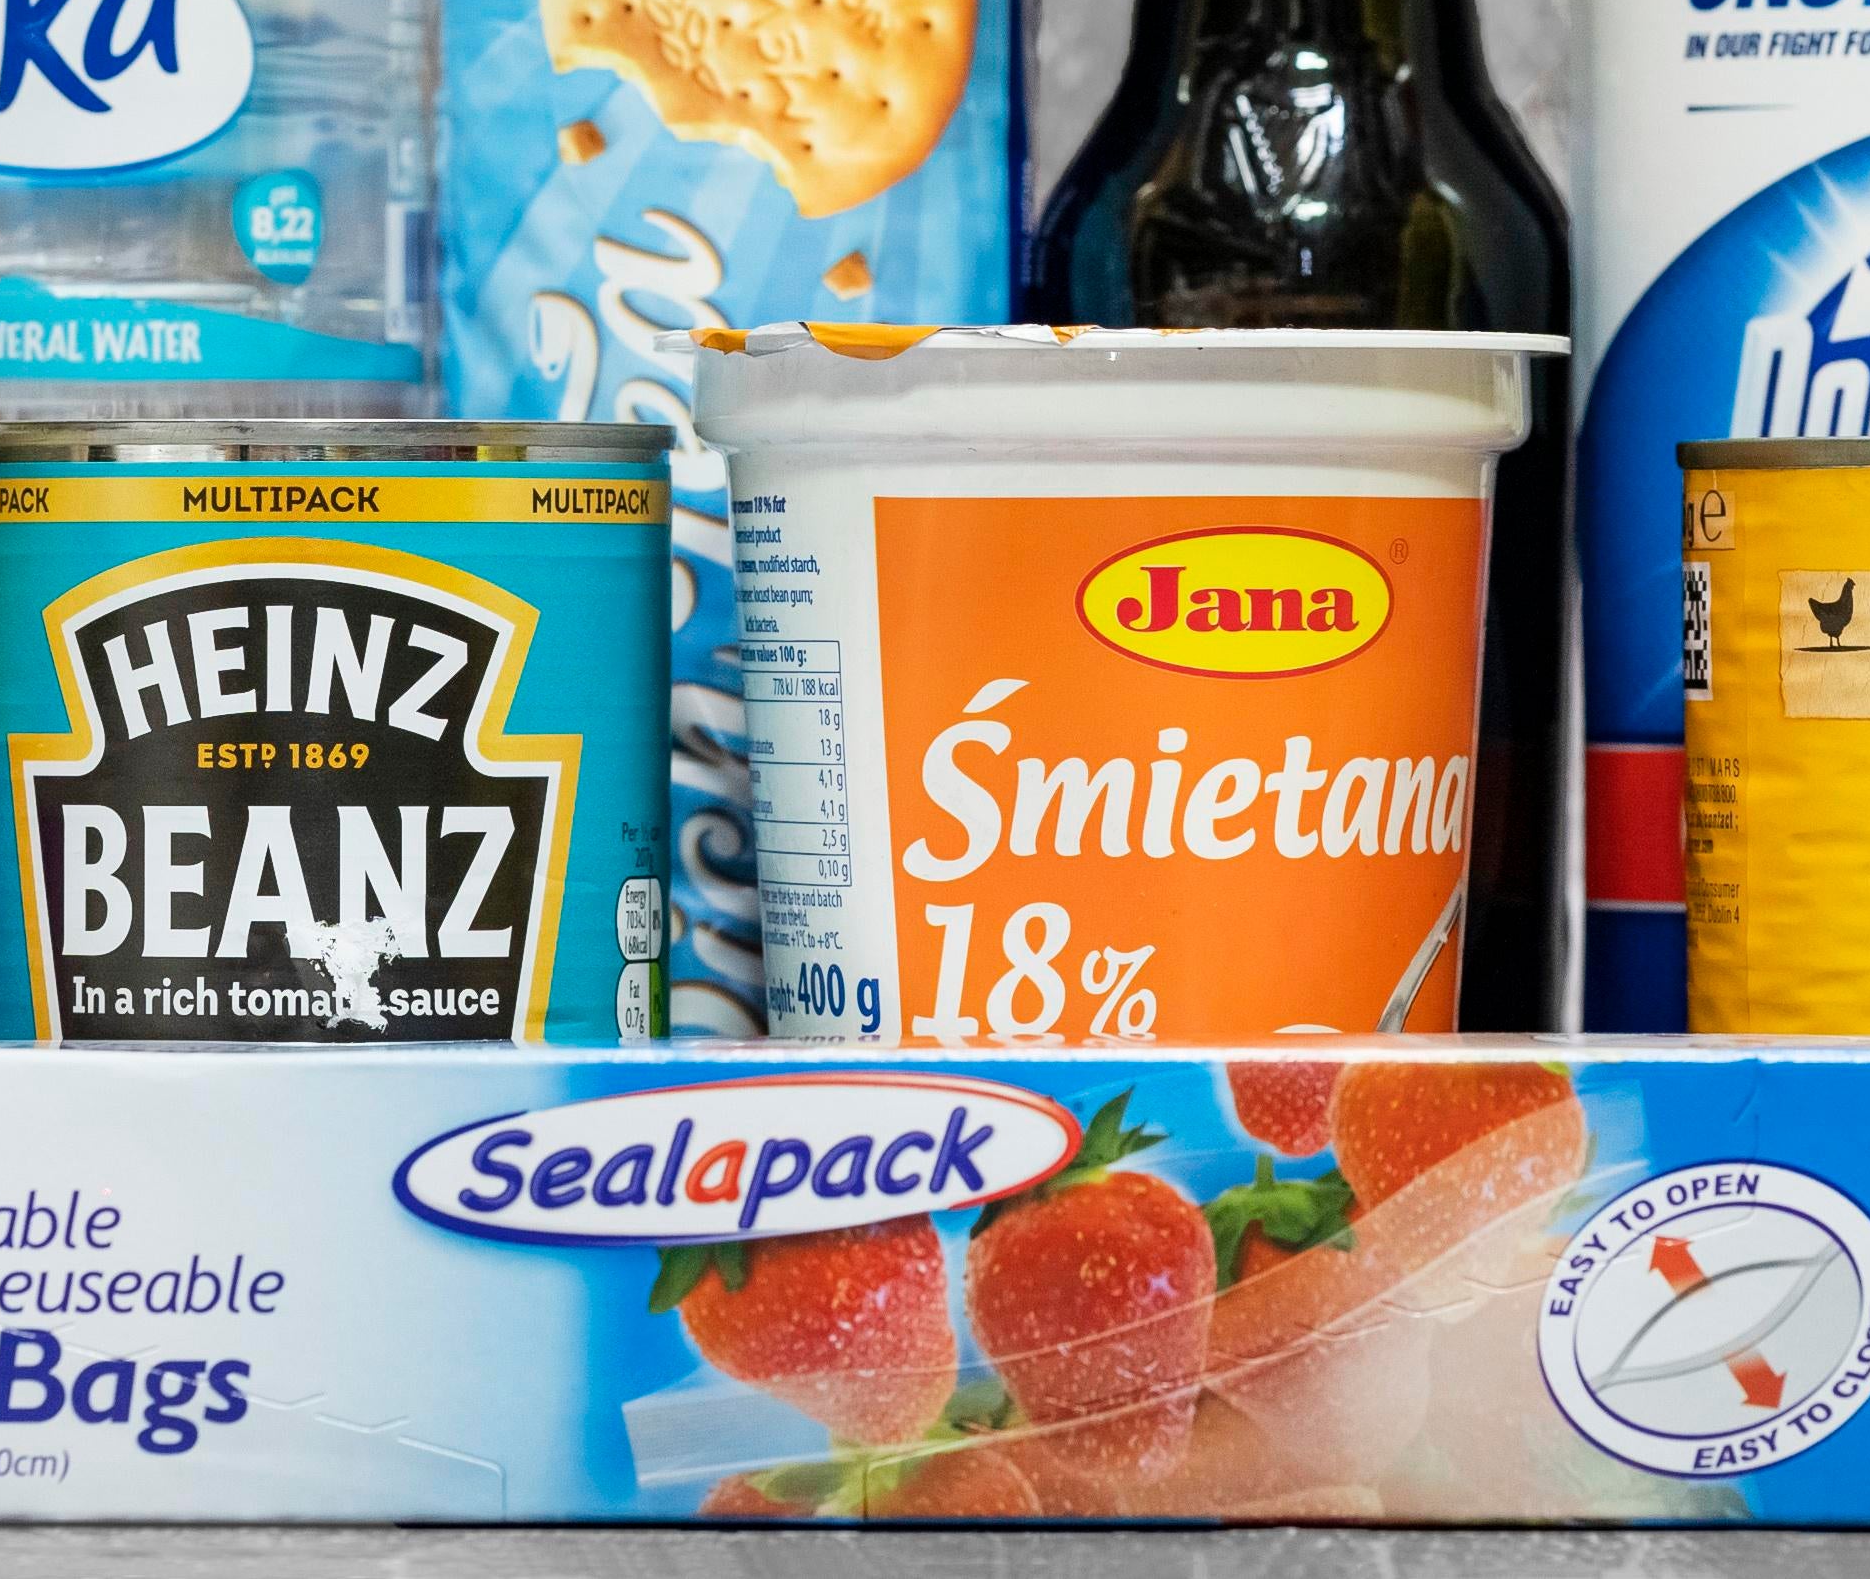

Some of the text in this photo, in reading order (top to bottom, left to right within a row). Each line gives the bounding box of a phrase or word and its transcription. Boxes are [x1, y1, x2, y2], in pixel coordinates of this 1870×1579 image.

[1685, 35, 1708, 60] IN
[1714, 33, 1763, 60] OUR
[1768, 31, 1837, 58] FIGHT
[92, 321, 201, 363] WATER
[183, 485, 380, 513] MULTIPACK
[531, 488, 650, 515] MULTIPACK
[772, 496, 786, 514] fat
[755, 527, 781, 548] product
[758, 555, 820, 575] modified starch,
[770, 585, 790, 603] bean
[790, 589, 813, 607] gum;
[1116, 565, 1359, 633] Jana
[779, 646, 795, 662] 100
[797, 649, 807, 667] g:
[102, 605, 468, 741] HEINZ
[801, 677, 839, 696] 188 kcal
[819, 709, 831, 726] 18
[289, 743, 370, 770] 1869
[820, 739, 832, 756] 13
[902, 678, 1469, 883] Śmietana
[61, 804, 515, 959] BEANZ
[625, 885, 647, 910] Energy
[802, 889, 842, 908] and batch
[1733, 905, 1740, 924] 4
[911, 902, 1157, 1036] 18%
[72, 975, 500, 1017] In a rich tomat sauce
[797, 962, 881, 1033] 400 g
[625, 1007, 645, 1034] 0.7g
[458, 1105, 995, 1230] Sealapack
[1549, 1173, 1760, 1318] EASY TO OPEN
[1692, 1428, 1780, 1473] EASY
[1786, 1401, 1834, 1438] TO
